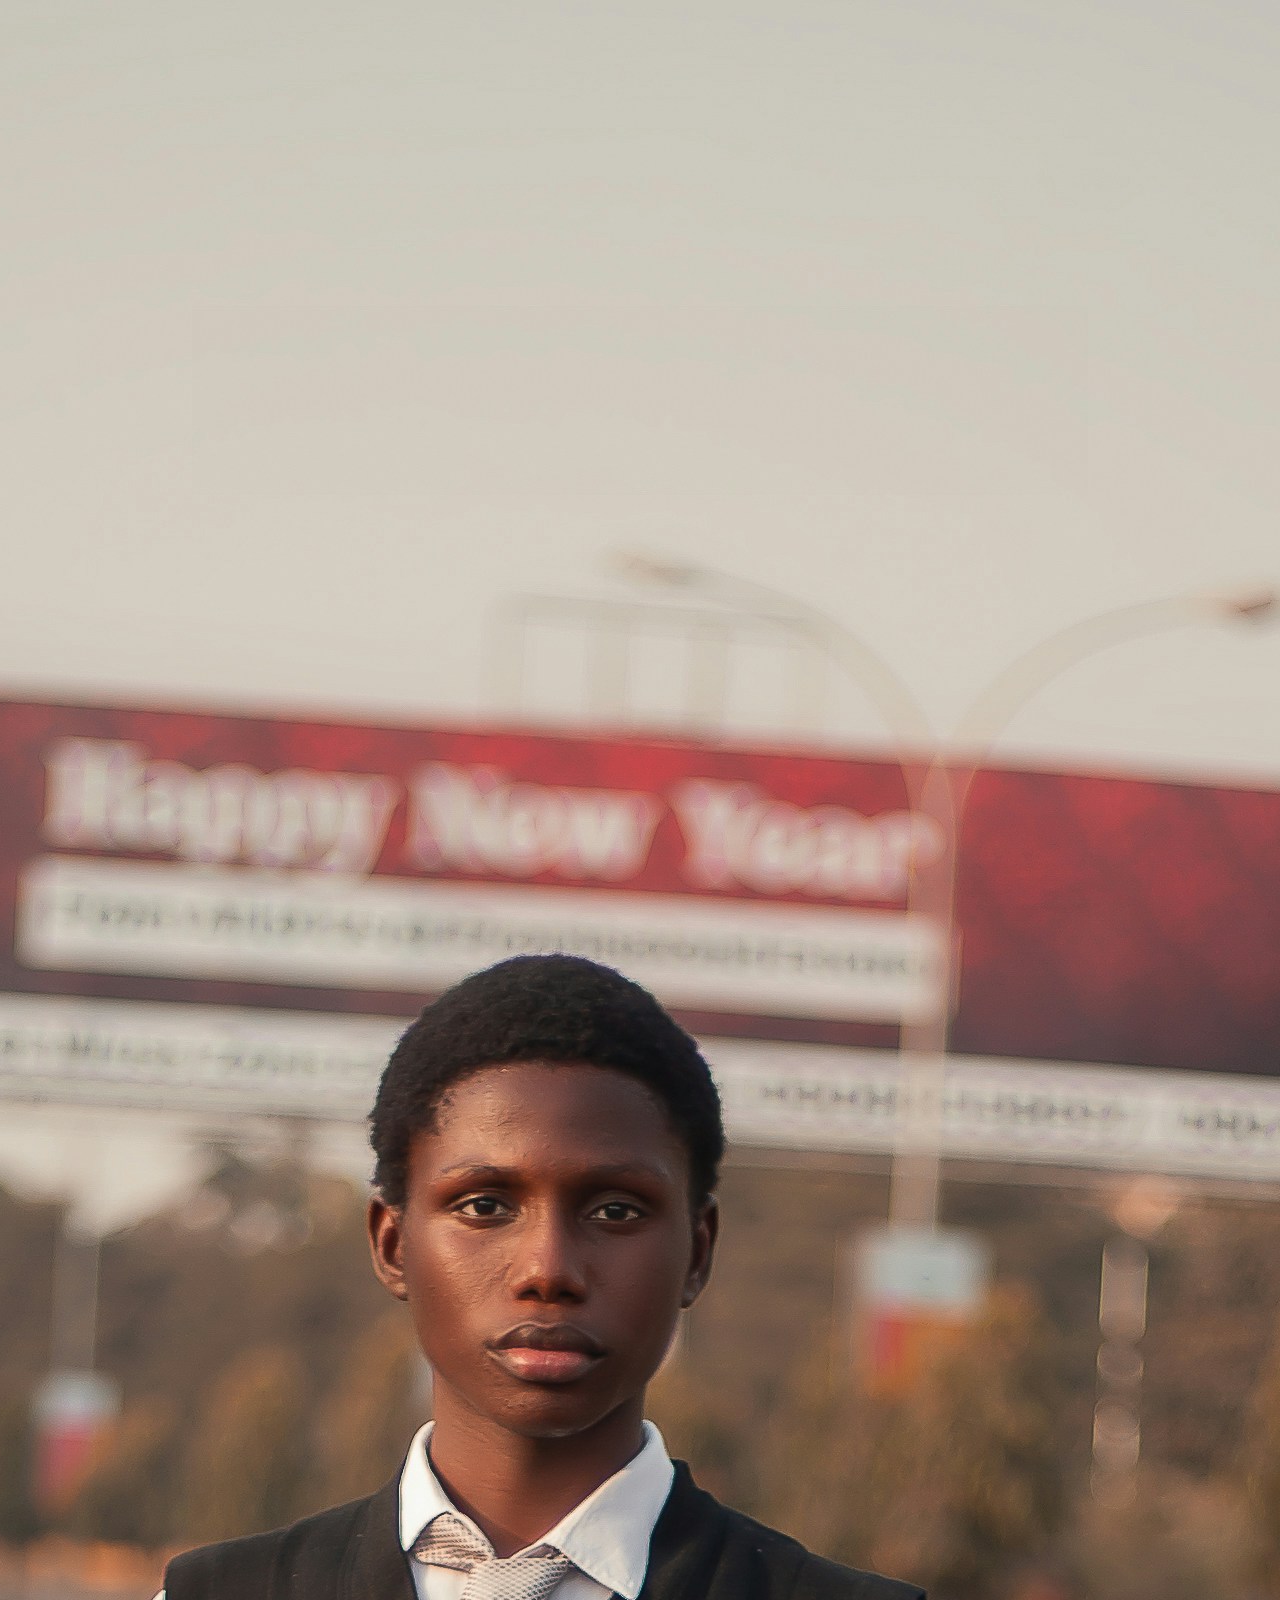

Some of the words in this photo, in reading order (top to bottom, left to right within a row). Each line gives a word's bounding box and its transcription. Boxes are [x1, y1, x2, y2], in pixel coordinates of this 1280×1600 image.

[46, 741, 398, 874] Happy
[406, 761, 664, 882] New
[668, 779, 942, 900] Year
